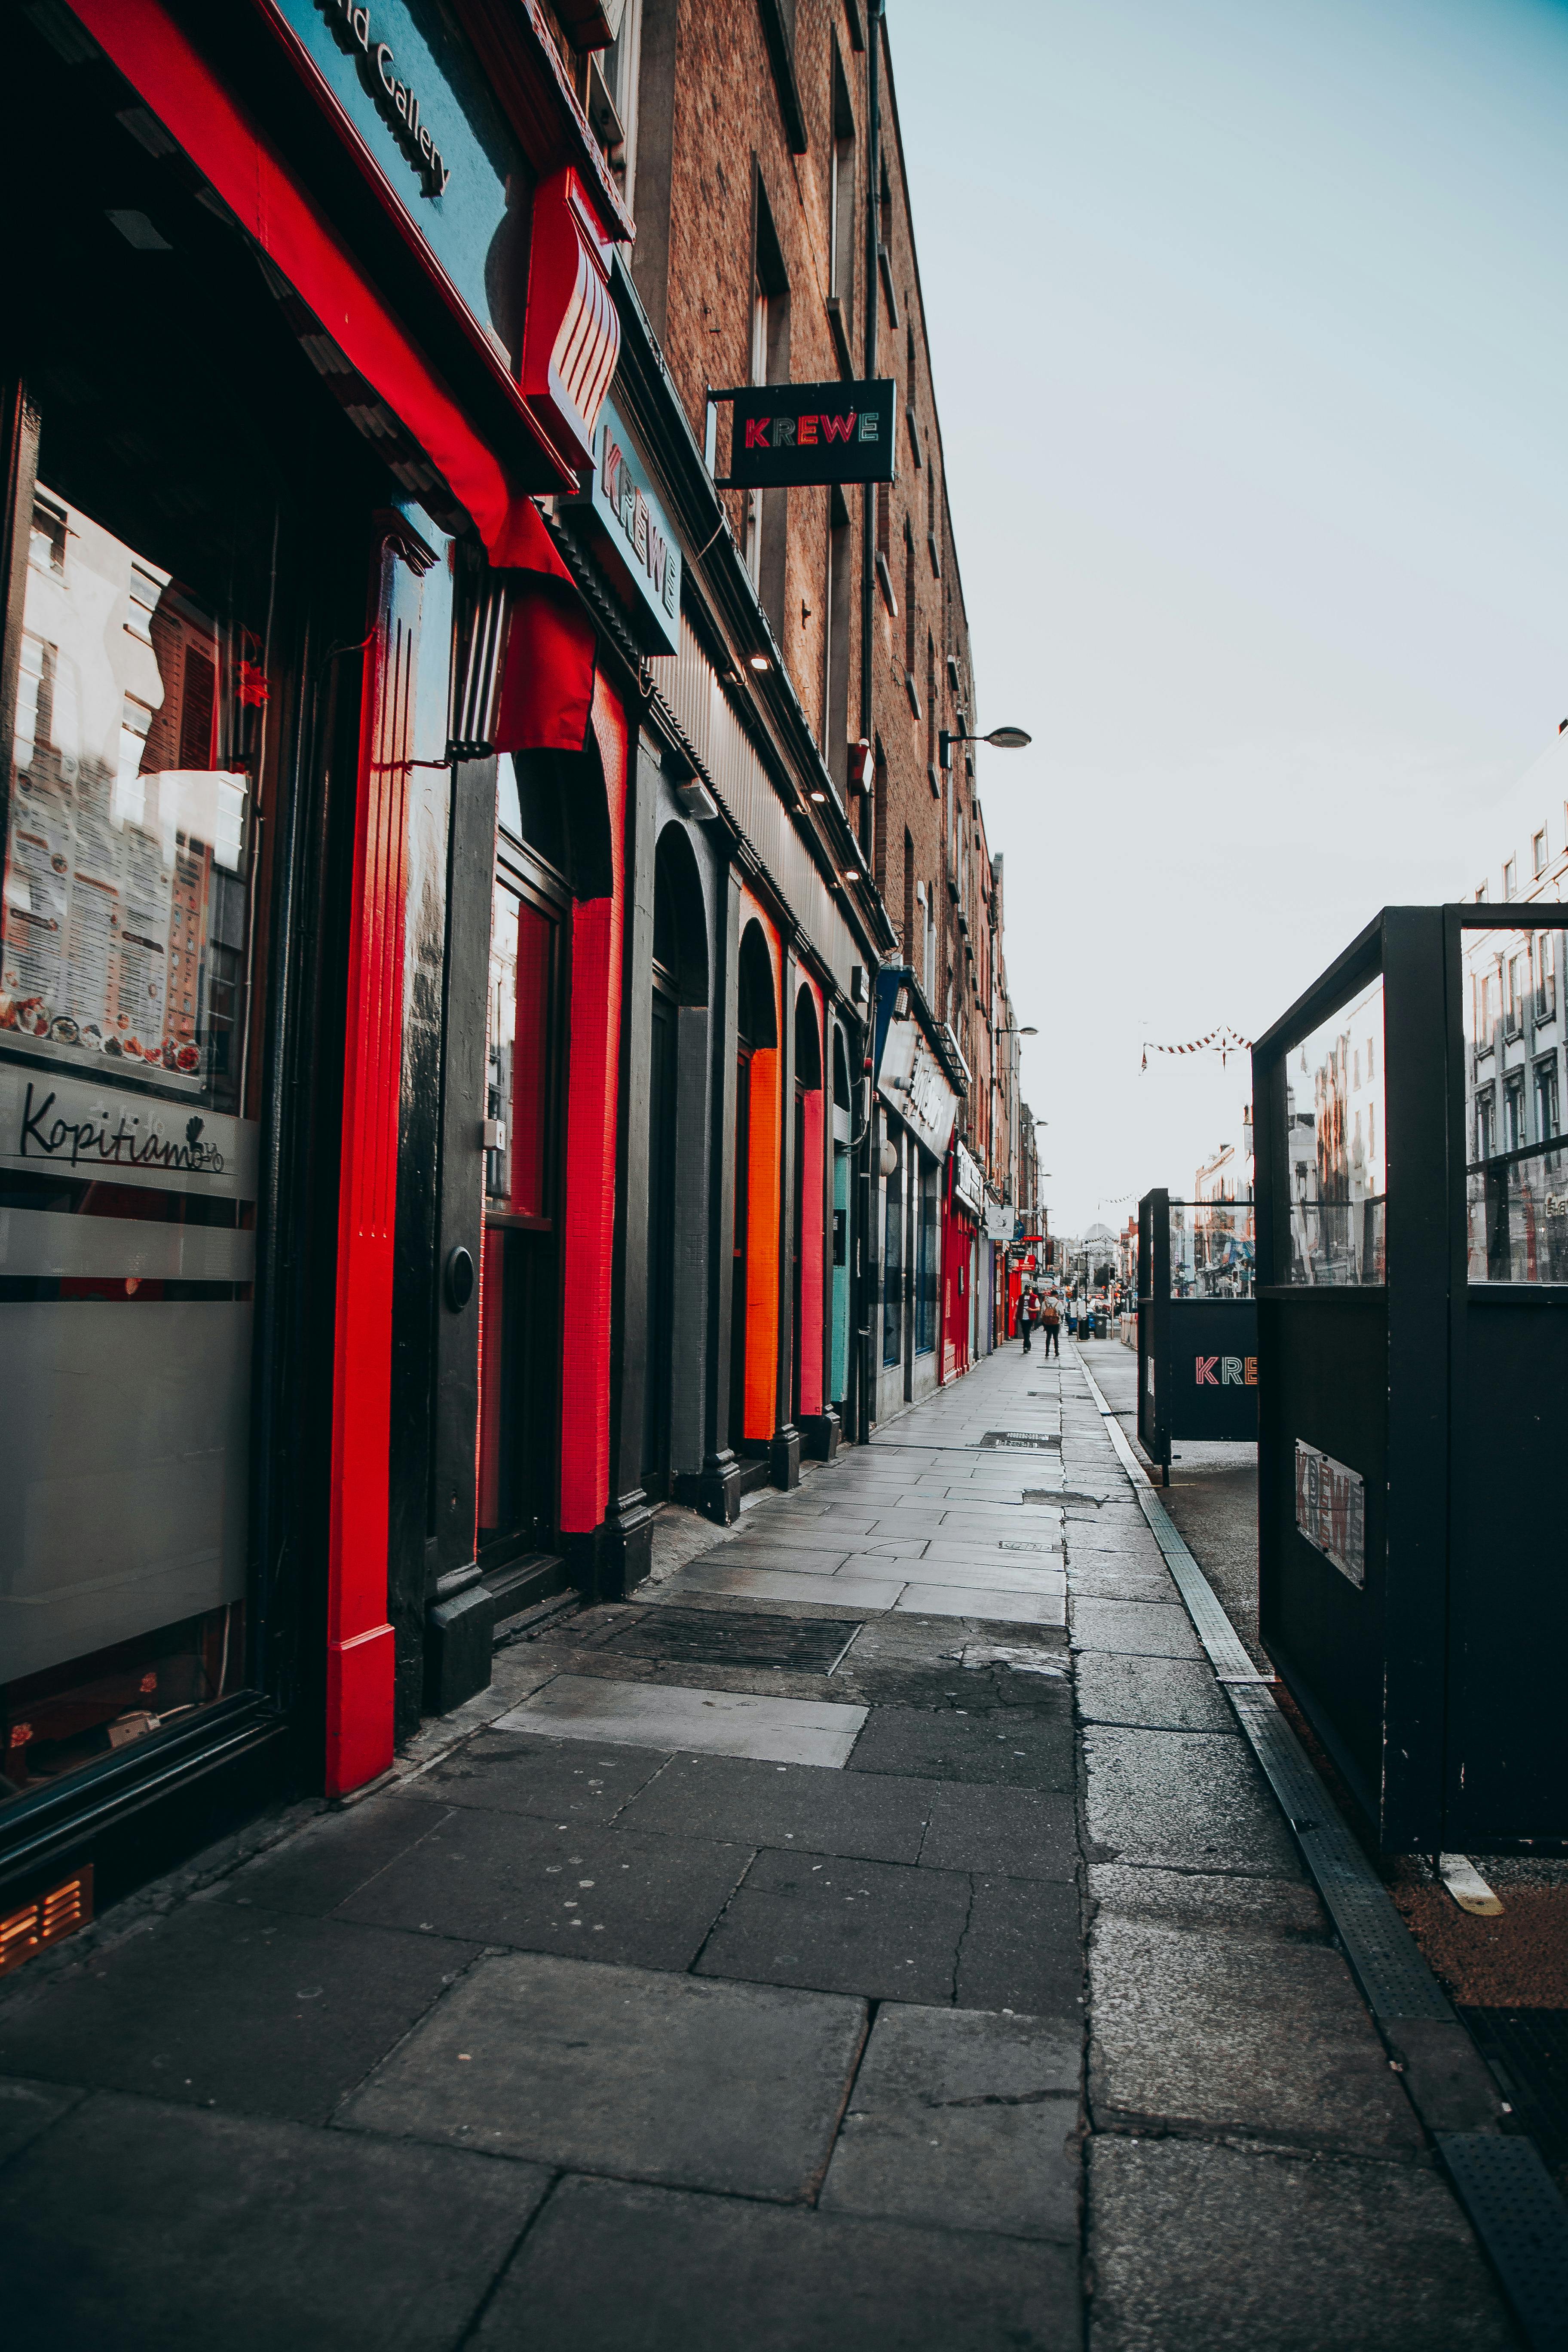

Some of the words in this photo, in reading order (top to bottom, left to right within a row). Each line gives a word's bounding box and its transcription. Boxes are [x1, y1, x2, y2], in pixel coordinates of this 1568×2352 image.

[377, 43, 450, 196] Gallery
[745, 412, 879, 448] KREWE
[602, 424, 675, 619] KREWE
[21, 1082, 195, 1168] Kopitiam
